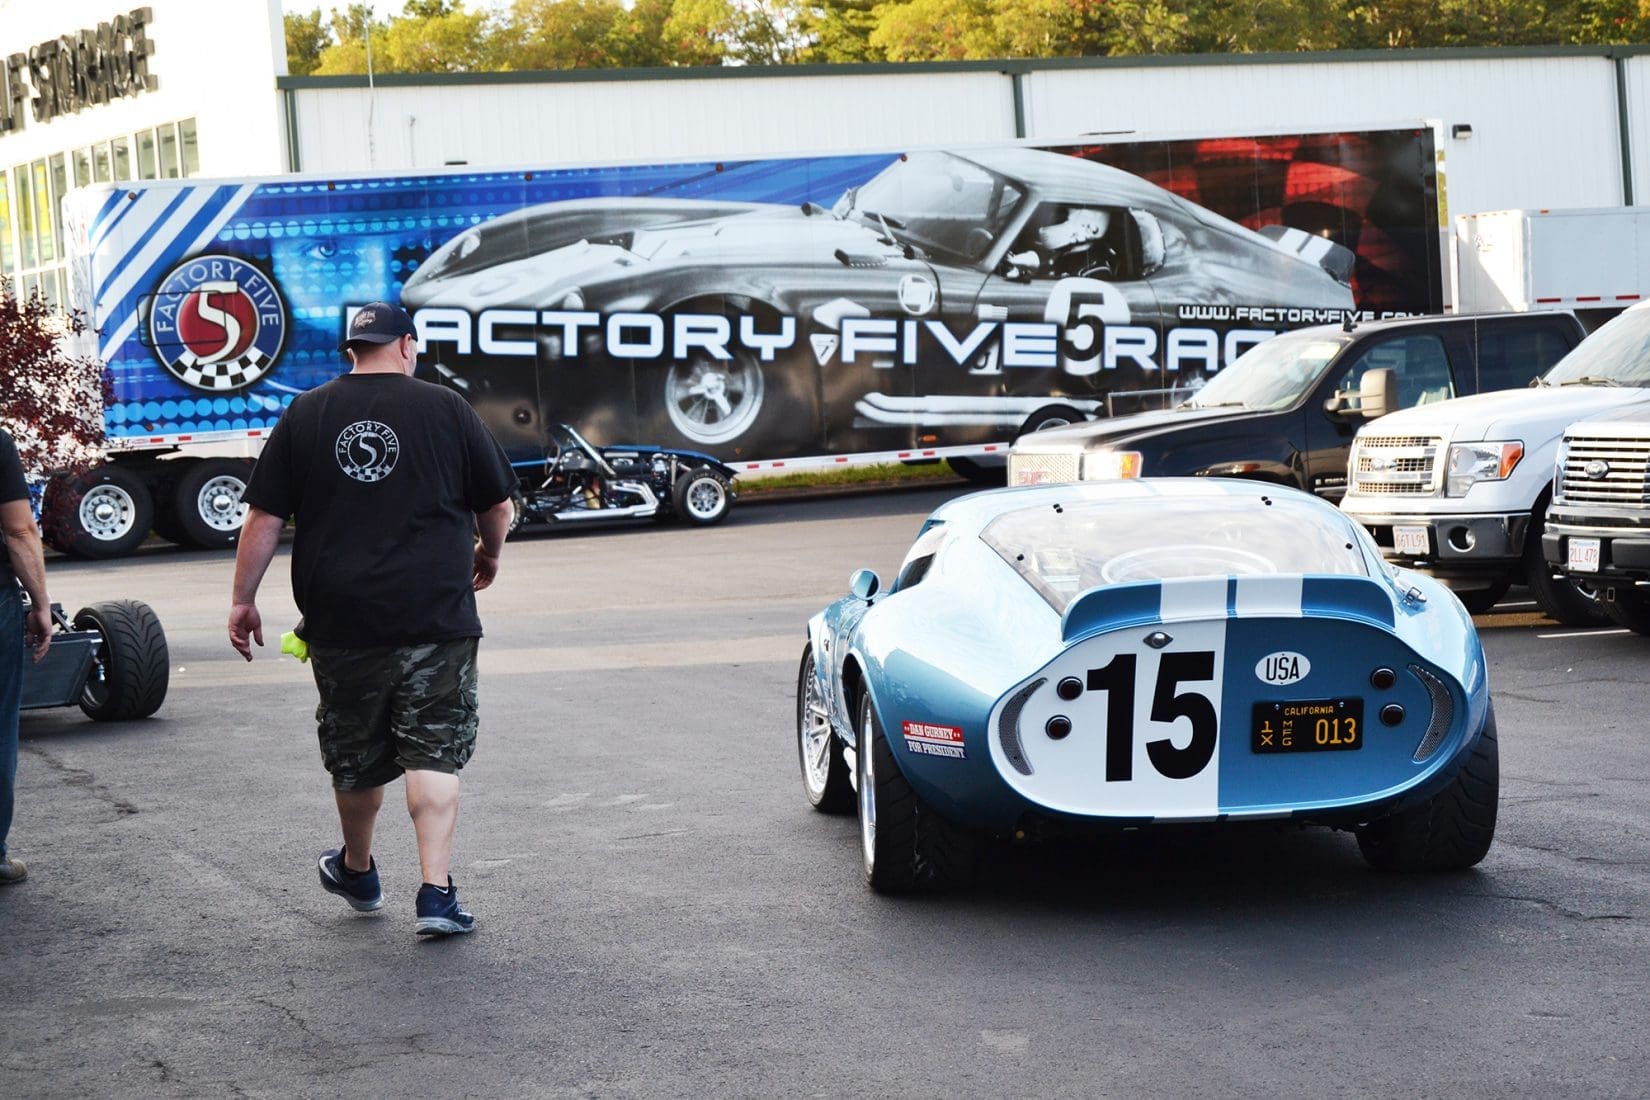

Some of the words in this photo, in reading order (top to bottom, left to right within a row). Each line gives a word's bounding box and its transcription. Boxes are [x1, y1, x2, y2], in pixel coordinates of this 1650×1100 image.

[156, 261, 242, 333] FACTORY
[244, 274, 279, 326] FIVE
[346, 305, 796, 360] ACTORY
[840, 318, 1058, 367] FIVE
[1103, 325, 1293, 372] RAC
[1063, 291, 1106, 363] 5
[339, 423, 381, 453] FACTORY
[381, 429, 397, 453] FIVE
[1266, 656, 1300, 681] USA
[1086, 651, 1218, 782] 15
[1284, 705, 1335, 716] CALIFORNIA
[1282, 720, 1293, 746] MFG
[1315, 717, 1357, 745] 013
[907, 740, 923, 753] FOR
[921, 742, 966, 759] PRESIDENT
